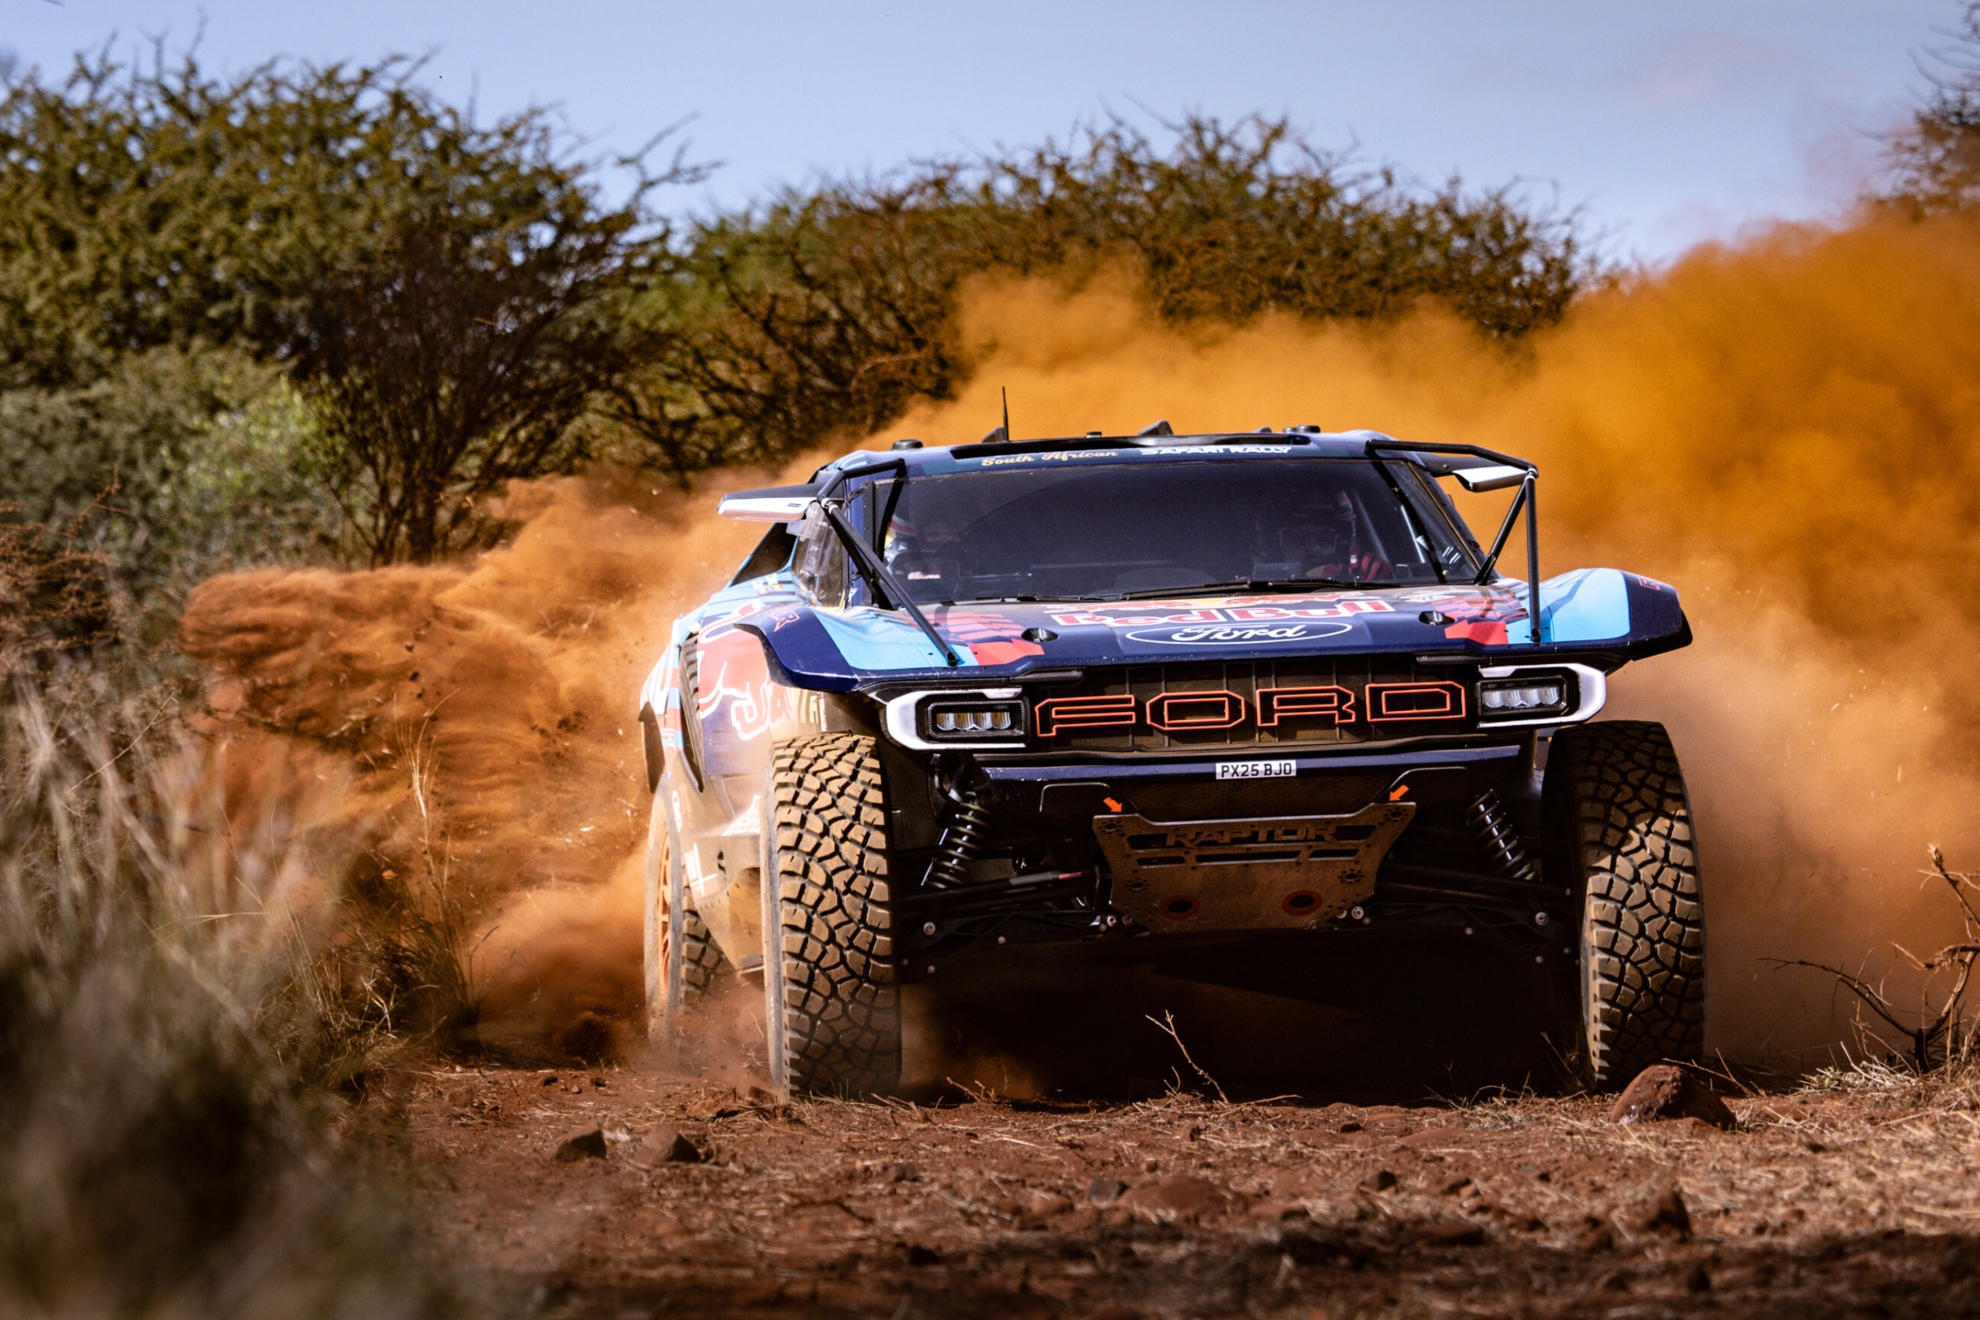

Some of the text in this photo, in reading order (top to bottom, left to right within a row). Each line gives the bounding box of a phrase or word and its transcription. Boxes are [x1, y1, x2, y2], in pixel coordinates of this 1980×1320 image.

[981, 454, 1035, 467] South
[1041, 450, 1119, 462] African
[1050, 600, 1396, 627] Red Bull
[1171, 623, 1307, 642] Ford
[1034, 680, 1467, 738] FORD
[1220, 762, 1292, 778] PX25 BJO
[1166, 824, 1338, 848] RAPTOR
